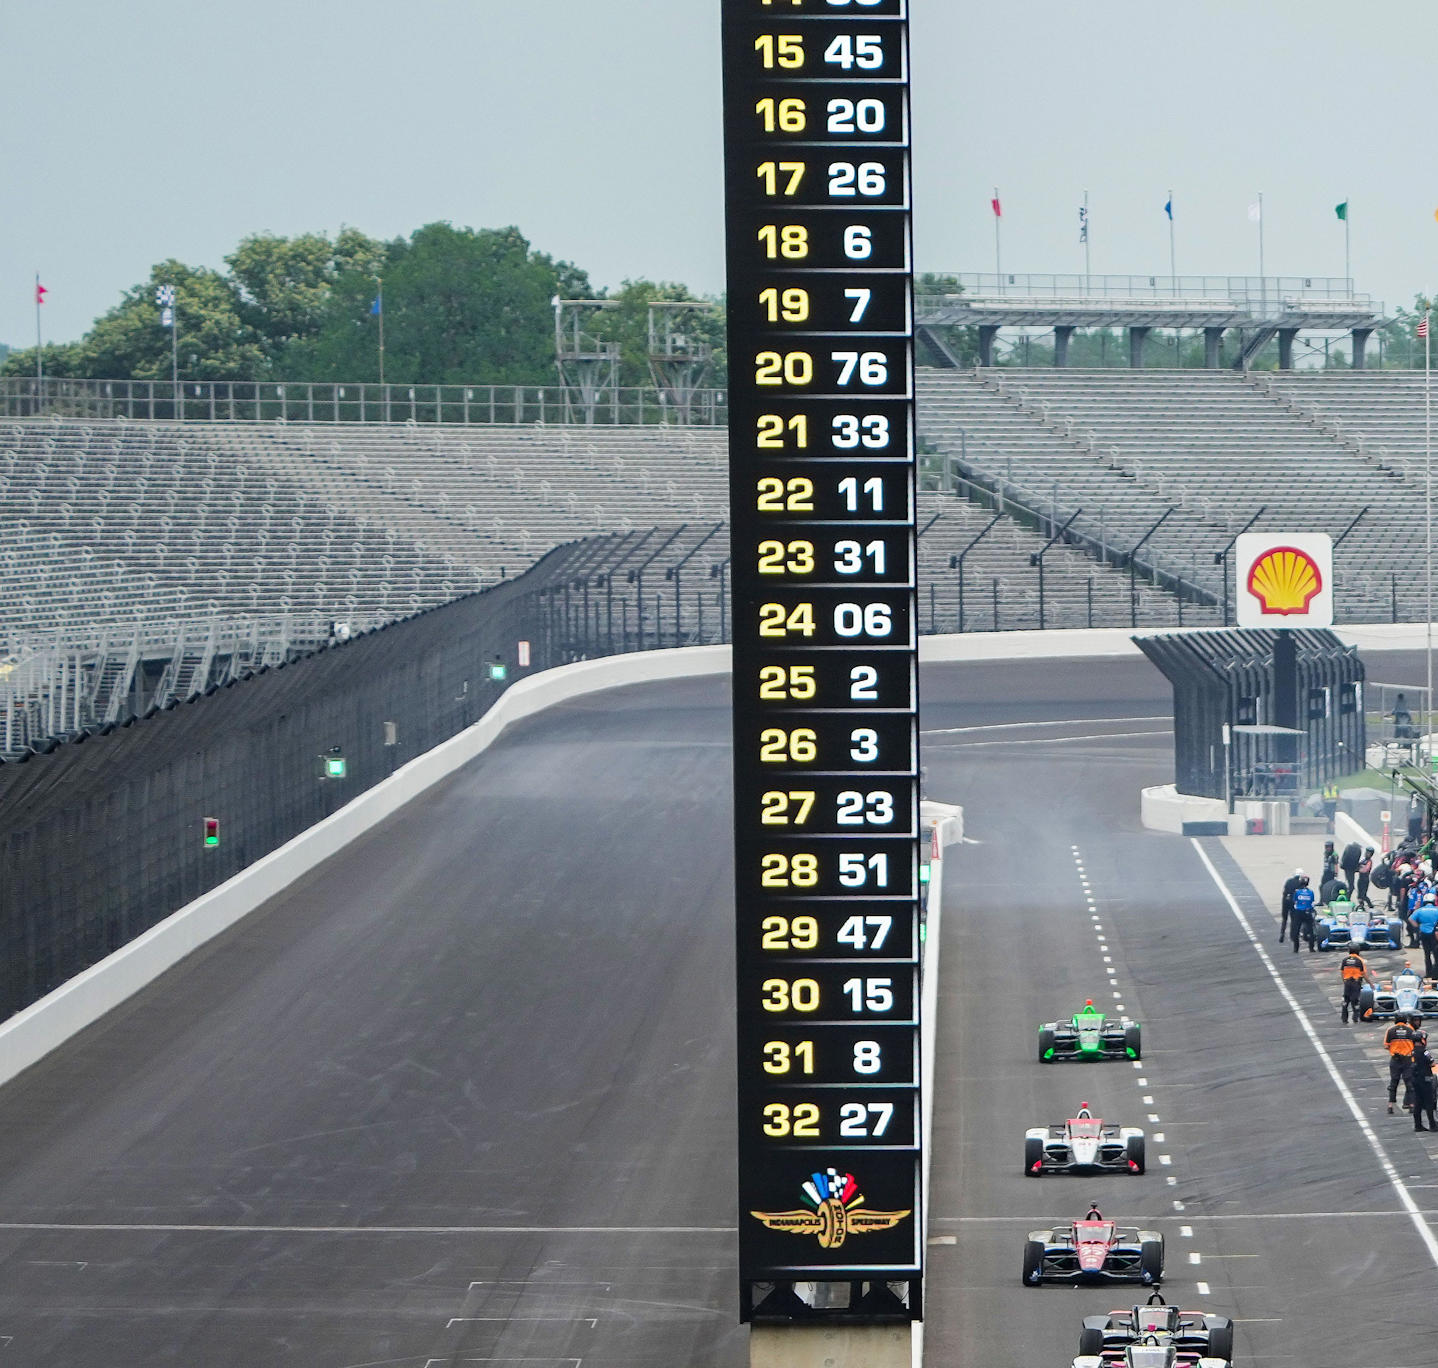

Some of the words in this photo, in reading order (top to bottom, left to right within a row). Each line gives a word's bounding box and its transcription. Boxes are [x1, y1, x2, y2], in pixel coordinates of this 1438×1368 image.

[755, 35, 804, 68] 15
[825, 36, 883, 69] 45
[756, 99, 805, 131] 16
[827, 99, 885, 133] 20
[758, 162, 805, 195] 17
[829, 163, 885, 196] 26
[758, 225, 808, 258] 18
[844, 226, 871, 259] 6
[760, 288, 808, 321] 19
[845, 289, 870, 322] 7
[756, 352, 812, 384] 20
[832, 352, 887, 386] 76
[757, 415, 806, 447] 21
[832, 415, 889, 448] 33
[758, 478, 813, 510] 22
[839, 478, 882, 511] 11
[758, 541, 814, 573] 23
[834, 541, 885, 574] 31
[760, 603, 815, 636] 24
[834, 603, 891, 637] 06
[760, 666, 815, 698] 25
[851, 666, 877, 699] 2
[761, 729, 816, 761] 26
[851, 729, 878, 761] 3
[762, 791, 815, 824] 27
[837, 791, 893, 824] 23
[762, 854, 818, 886] 28
[840, 854, 887, 887] 51
[762, 916, 818, 949] 29
[837, 916, 892, 949] 47
[763, 979, 819, 1011] 30
[844, 978, 893, 1011] 15
[763, 1041, 813, 1073] 31
[854, 1041, 881, 1074] 8
[764, 1104, 819, 1136] 32
[840, 1103, 893, 1136] 27
[851, 1218, 891, 1226] SPEEDWAY
